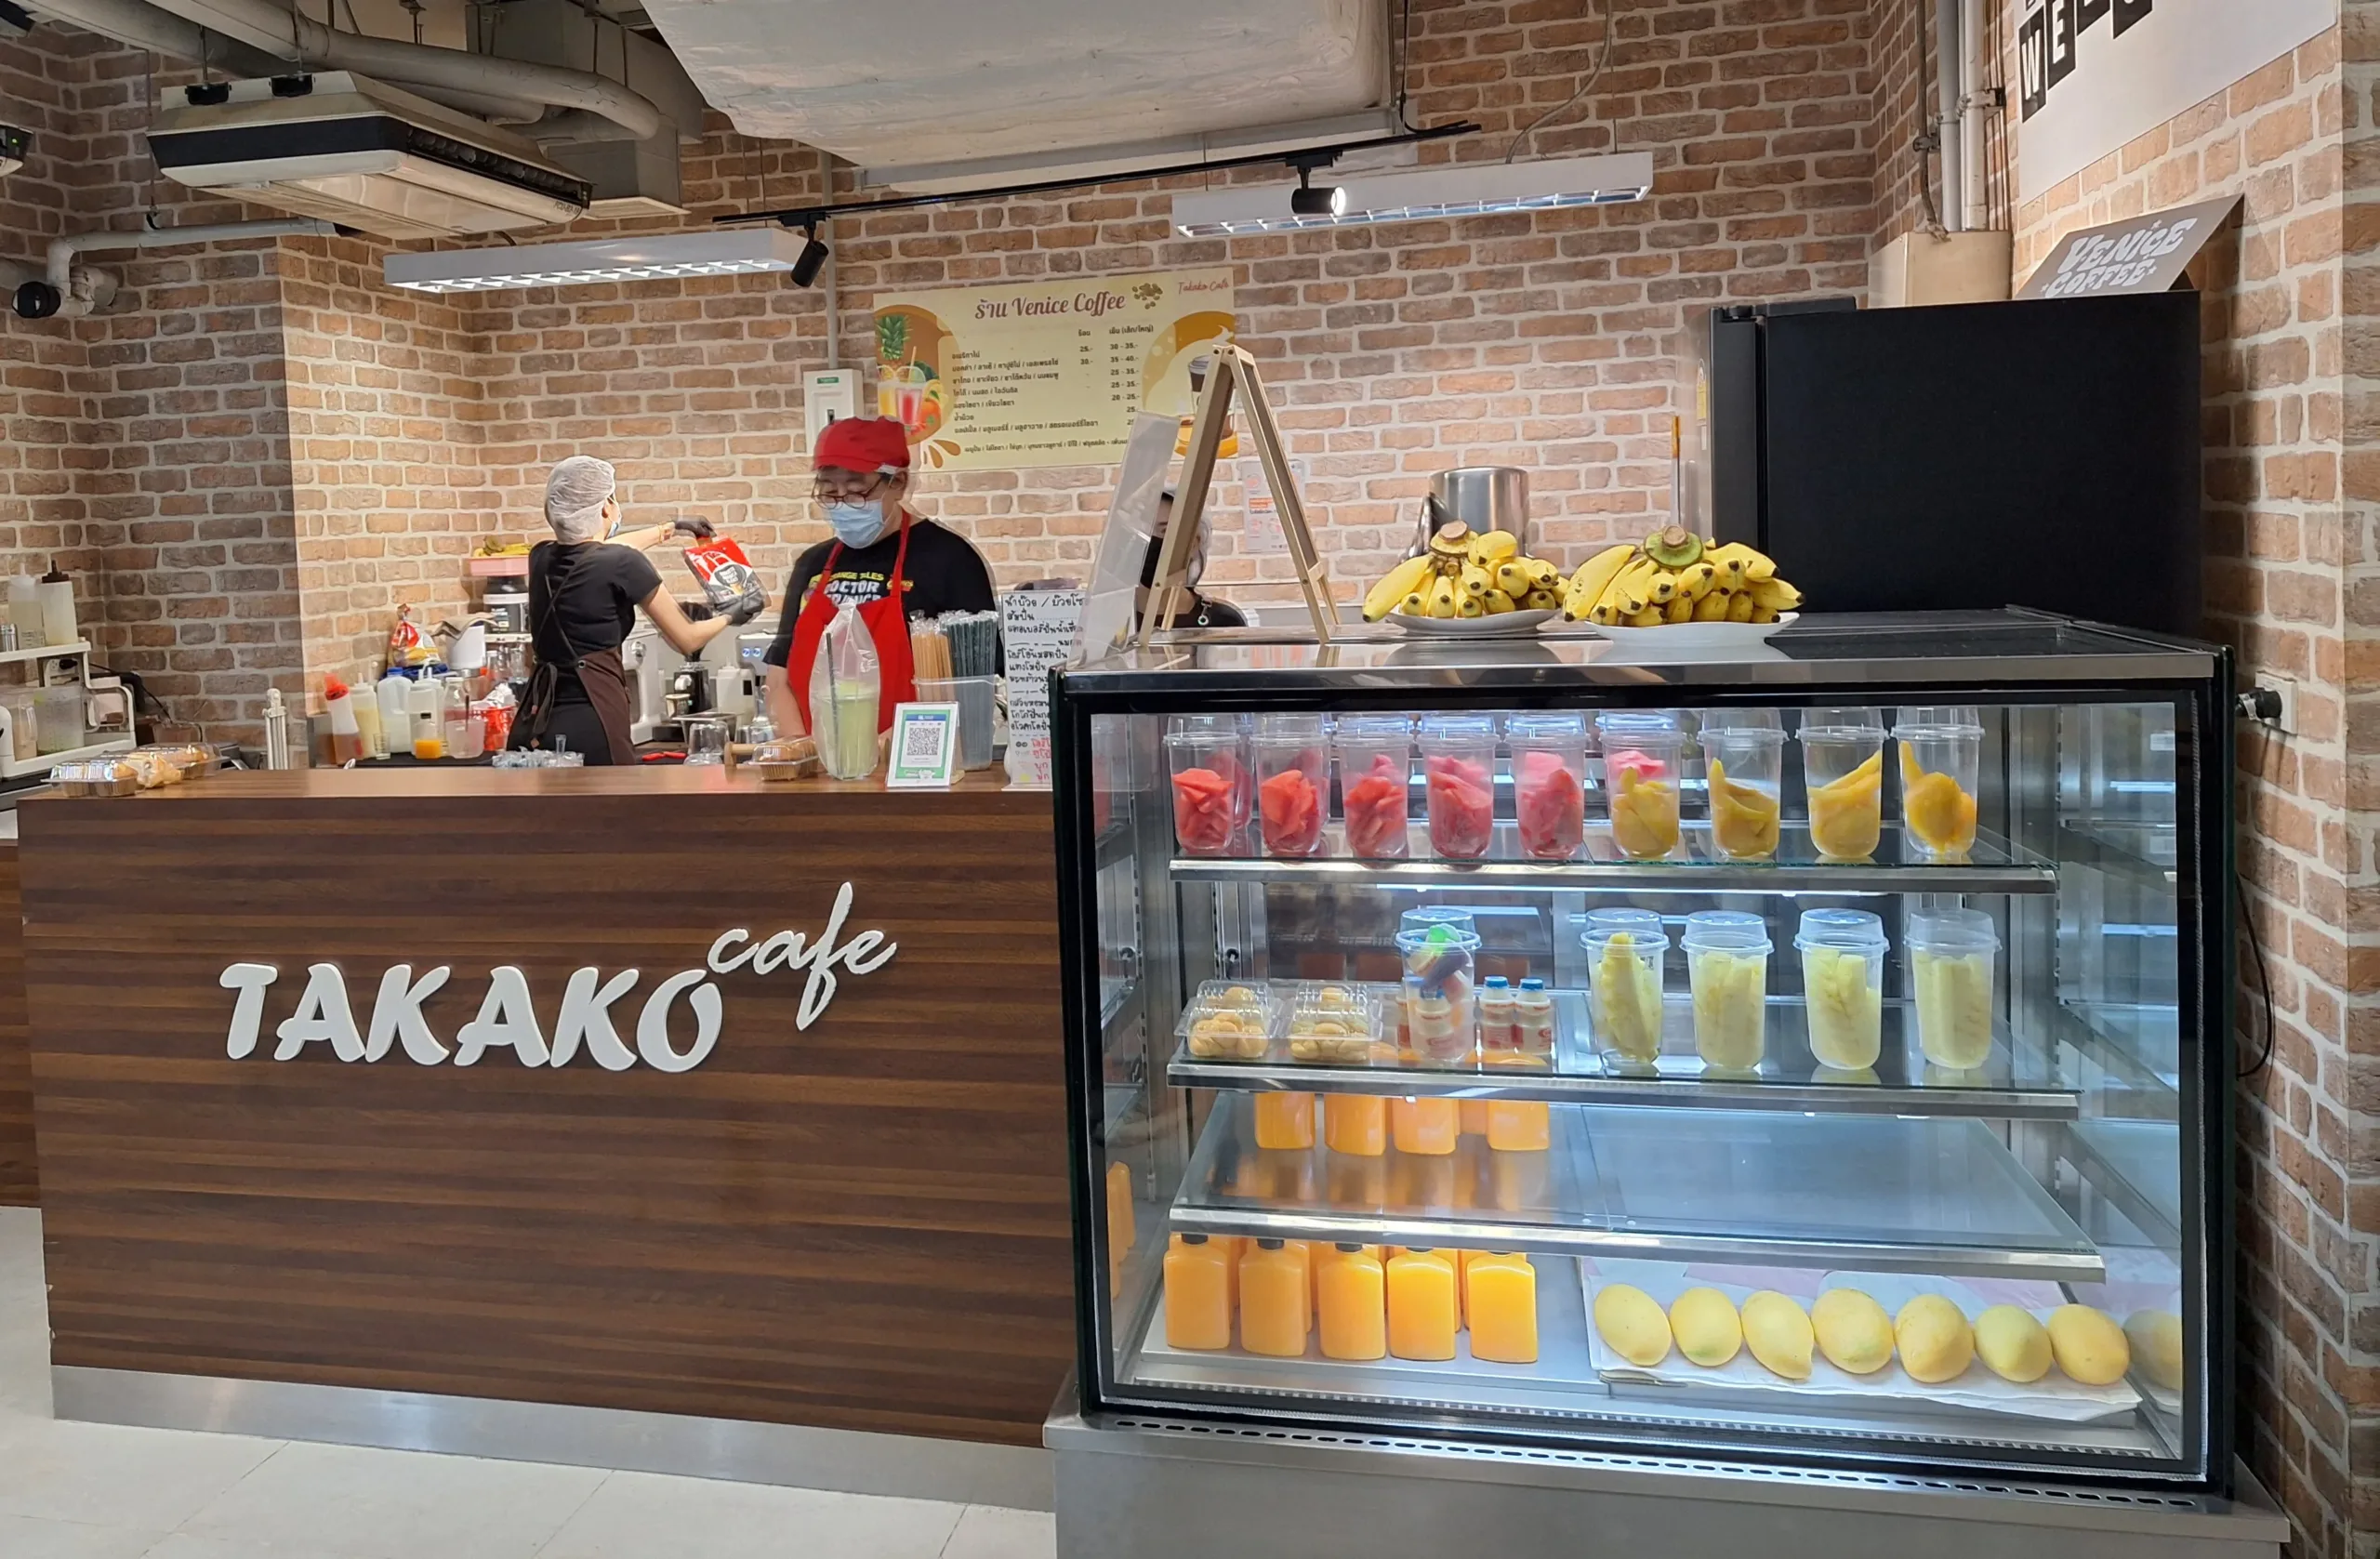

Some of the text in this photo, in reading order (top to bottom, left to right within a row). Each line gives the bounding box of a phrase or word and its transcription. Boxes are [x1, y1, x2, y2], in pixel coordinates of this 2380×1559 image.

[2057, 218, 2198, 275] VENICE
[1178, 280, 1208, 295] Takako
[2044, 258, 2156, 298] COFFEE
[974, 291, 1125, 319] ร้าน Venice Coffee
[707, 881, 897, 1030] cafe
[219, 963, 723, 1073] TAKAKO
